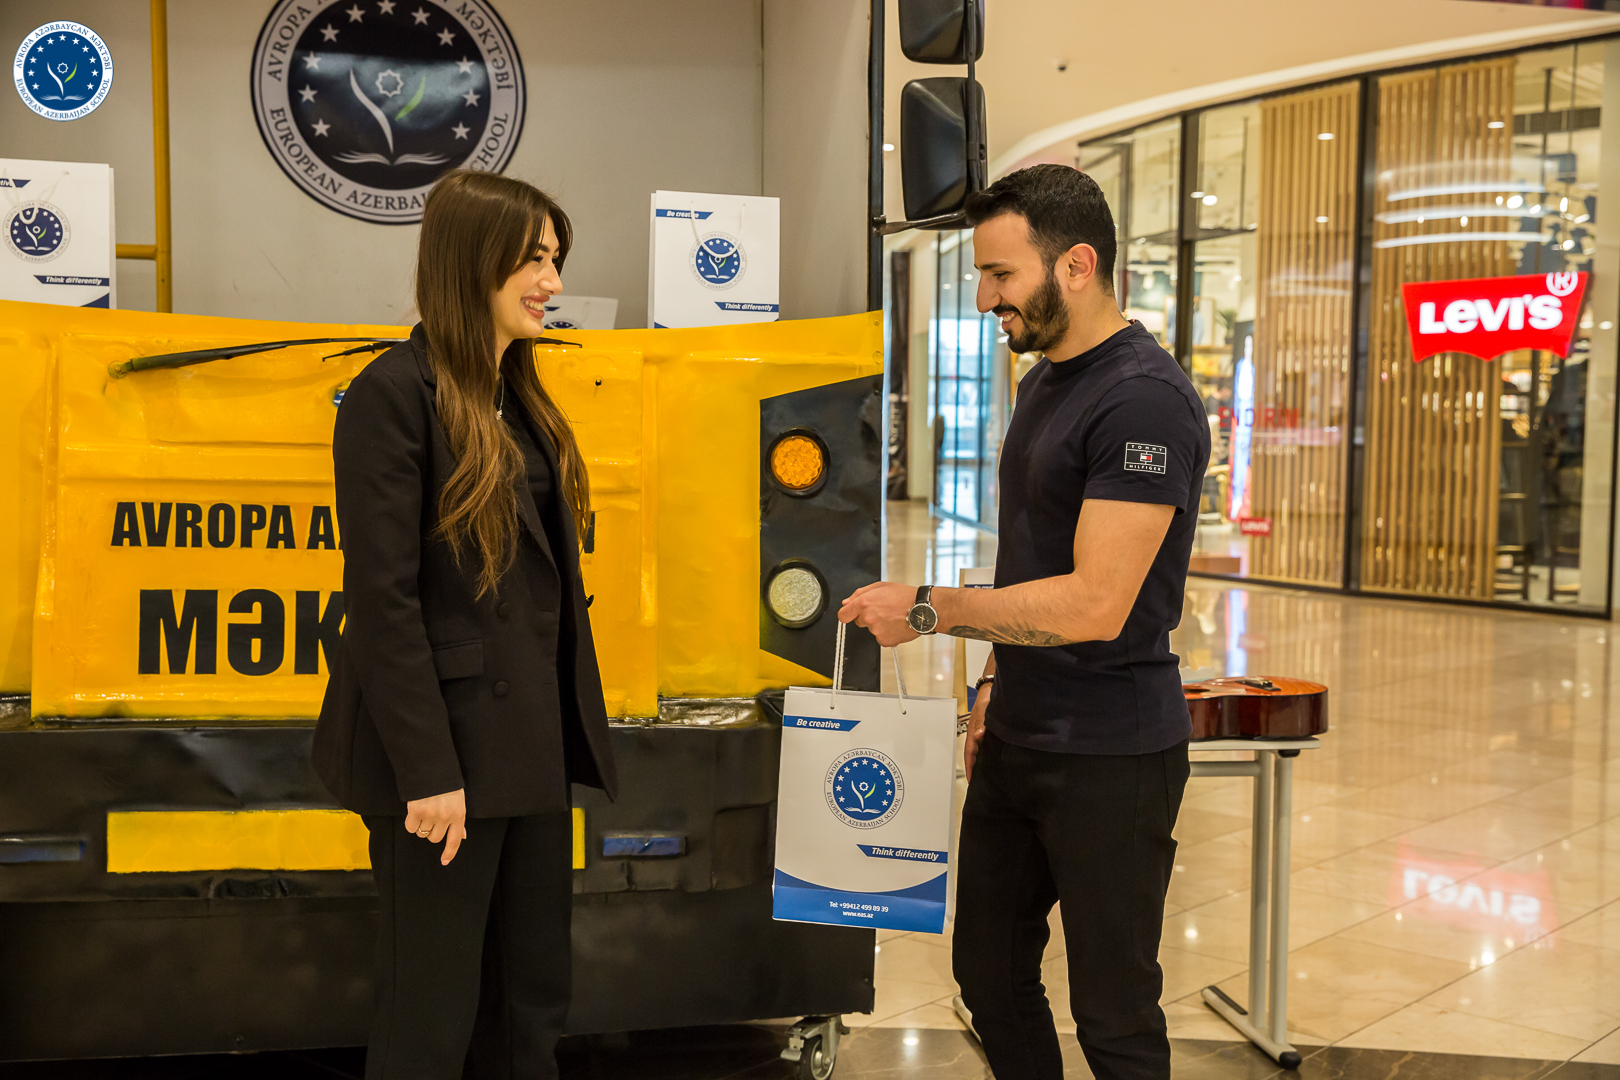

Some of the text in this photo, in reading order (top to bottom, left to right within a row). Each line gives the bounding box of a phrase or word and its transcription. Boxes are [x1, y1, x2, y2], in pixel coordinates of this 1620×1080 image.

[267, 5, 312, 82] AVROPA
[269, 106, 509, 210] EUROPEAN AZERBAI CHOOL
[675, 211, 700, 219] create
[46, 276, 103, 286] Think differently
[725, 302, 773, 312] Think differently
[1131, 444, 1163, 452] TOMMY
[1128, 464, 1162, 472] HILFIGER
[110, 501, 297, 550] AVROPA
[796, 718, 841, 729] Be creative
[827, 760, 842, 784] AVROPA
[826, 791, 848, 821] EUROPEAN
[884, 797, 901, 820] SCHOOL
[871, 846, 940, 861] Think differently
